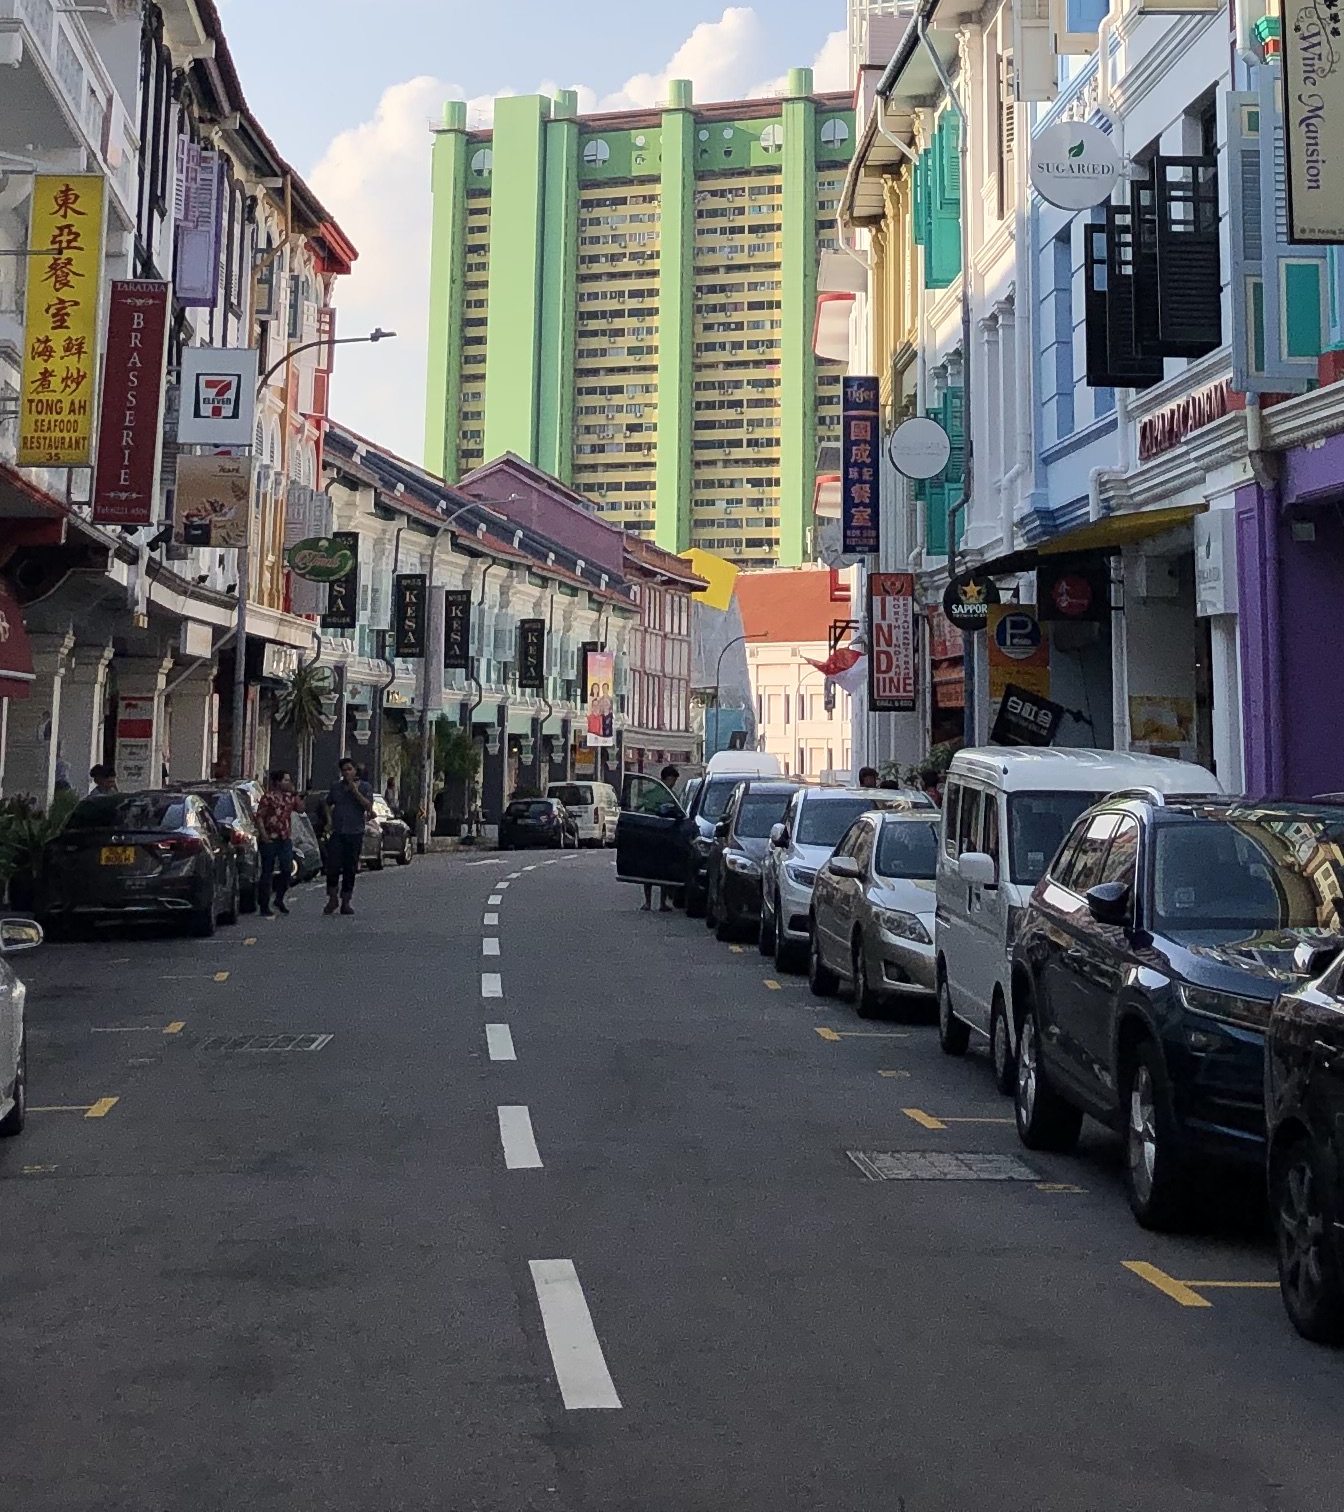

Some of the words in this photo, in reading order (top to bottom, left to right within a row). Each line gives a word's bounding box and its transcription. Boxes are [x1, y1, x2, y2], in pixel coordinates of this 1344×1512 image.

[1298, 93, 1327, 191] Mansion
[1037, 162, 1115, 175] SUGAR(ED)
[41, 183, 88, 330] 東亞餐室
[117, 282, 168, 292] TARATATA
[119, 312, 145, 486] BRASSERIE
[202, 397, 232, 405] ELEVEN
[846, 386, 876, 403] Tiger
[27, 398, 63, 416] TONG
[68, 399, 87, 416] AH
[33, 418, 79, 434] SEAFOOD
[22, 435, 88, 451] RESTAURANT
[405, 590, 417, 643] KESA
[952, 603, 988, 614] SAPPOR
